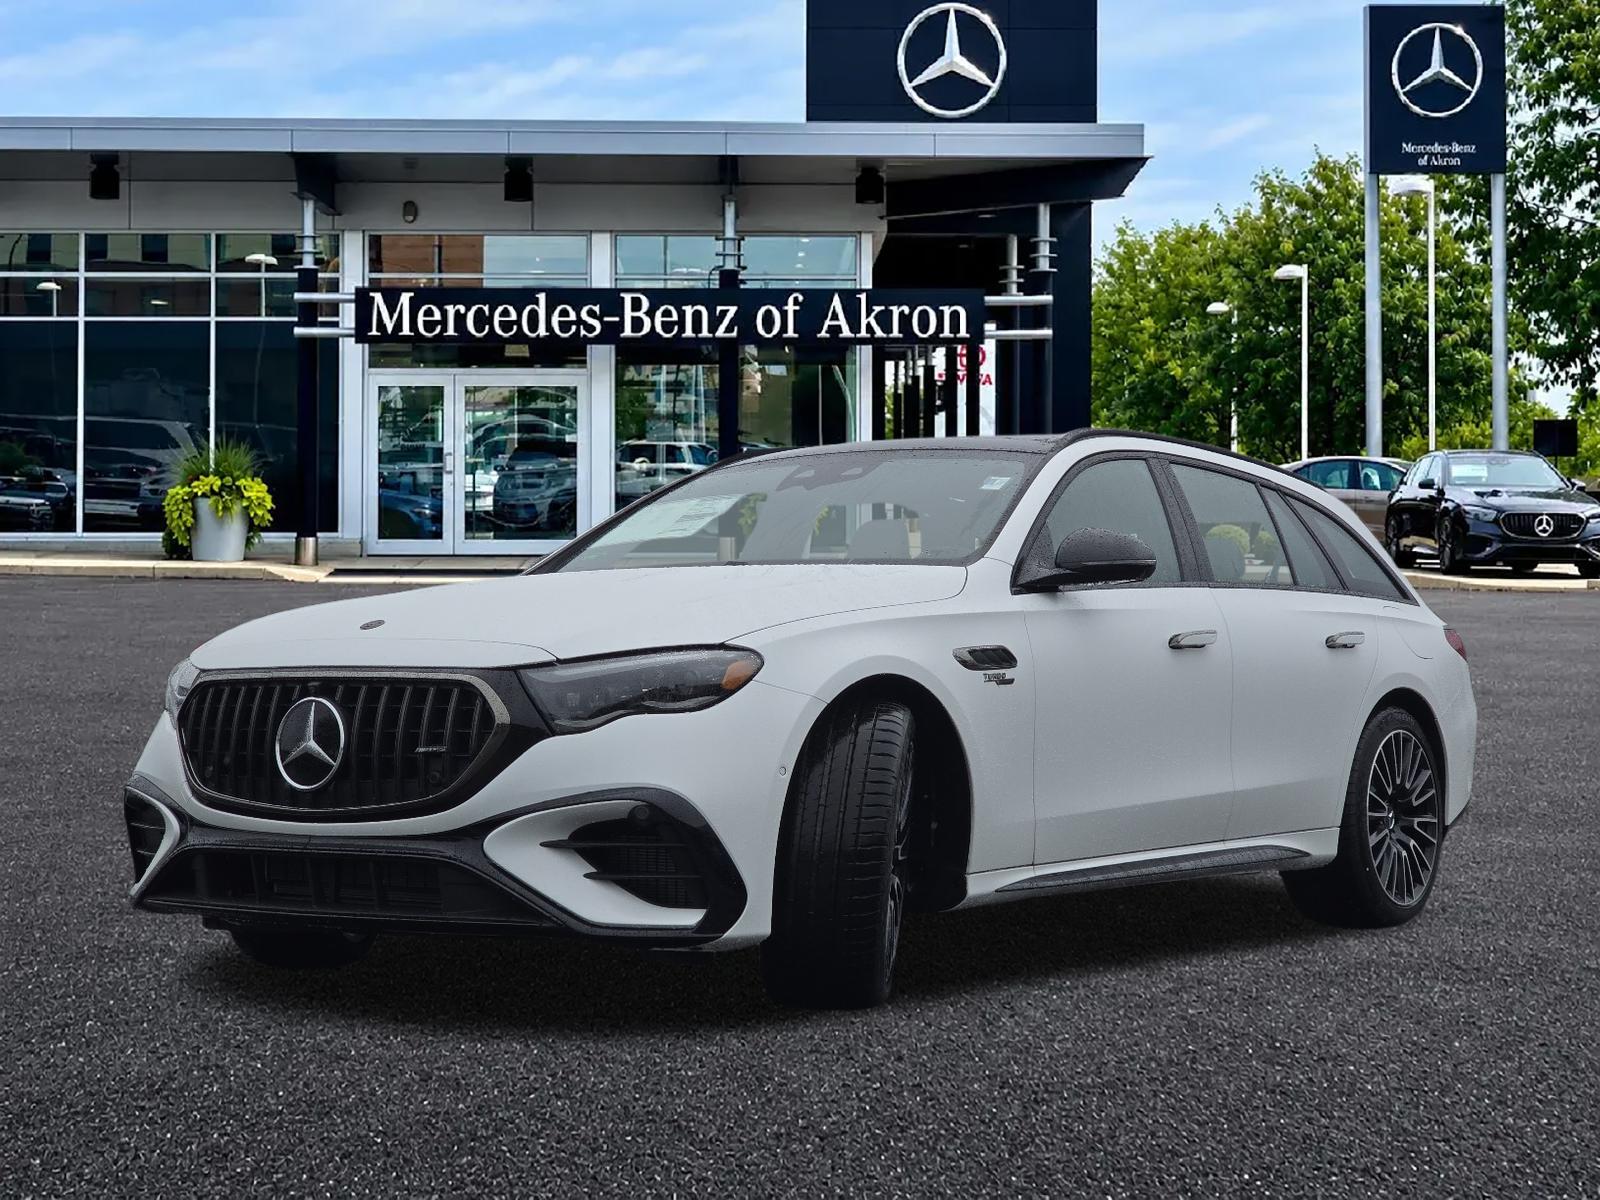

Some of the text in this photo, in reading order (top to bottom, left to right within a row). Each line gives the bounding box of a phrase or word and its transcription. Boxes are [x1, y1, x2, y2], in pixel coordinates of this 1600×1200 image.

[1401, 142, 1476, 153] Mercedes-Benz
[1418, 155, 1461, 166] of Akron
[367, 291, 970, 339] Mercedes-Benz of Akron
